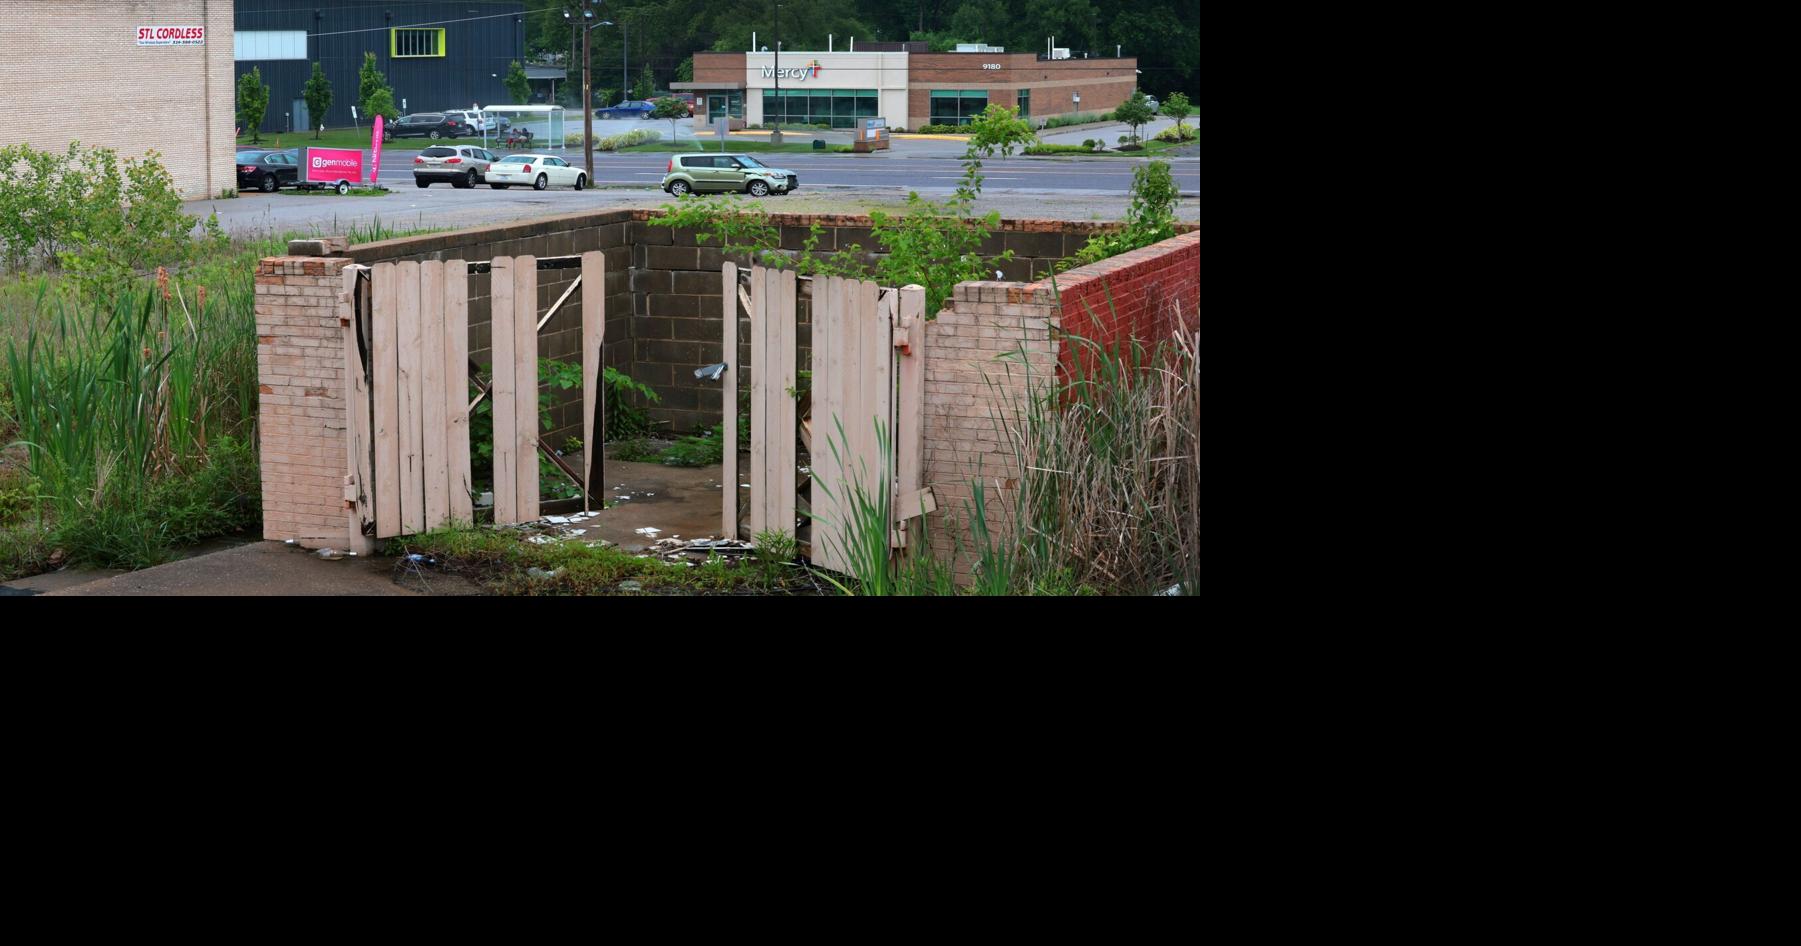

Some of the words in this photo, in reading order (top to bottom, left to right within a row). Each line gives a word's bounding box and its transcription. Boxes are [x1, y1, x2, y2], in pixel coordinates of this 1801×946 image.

[138, 28, 154, 39] STL
[156, 28, 203, 39] CORDLESS
[761, 65, 808, 81] Mercy
